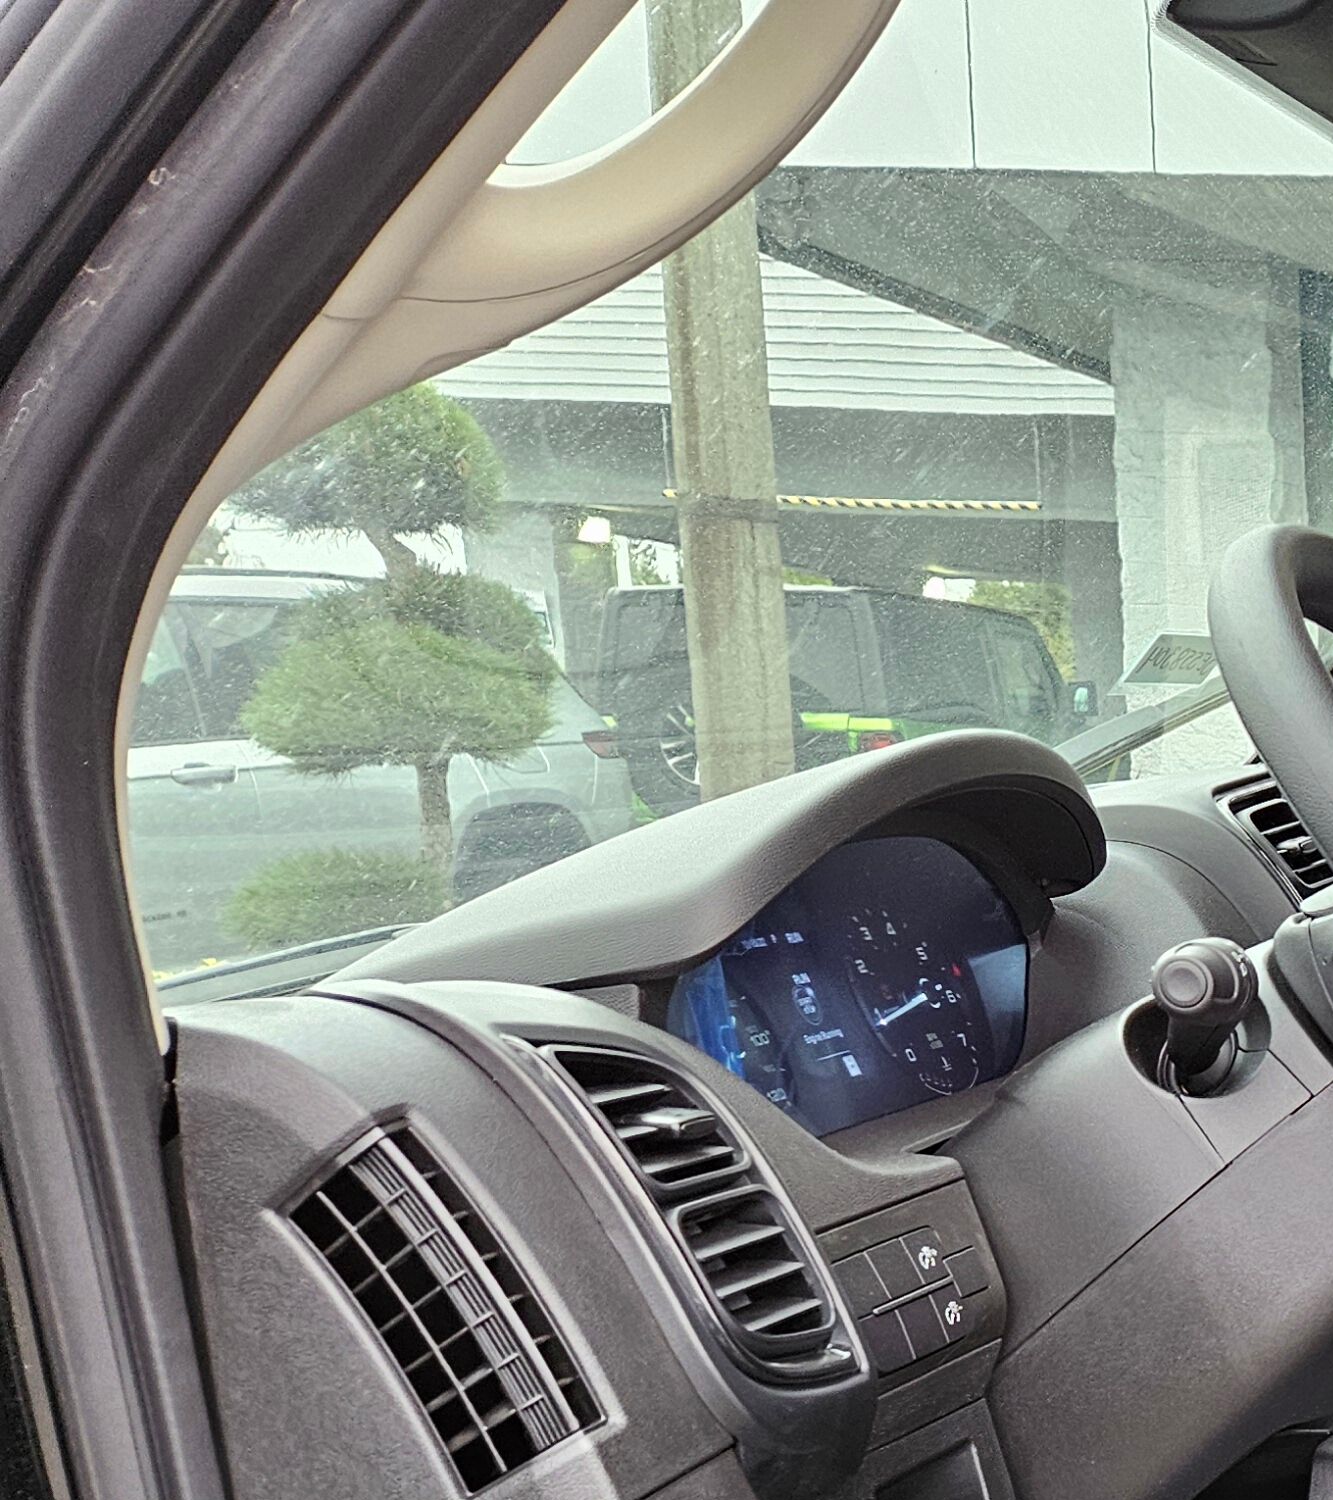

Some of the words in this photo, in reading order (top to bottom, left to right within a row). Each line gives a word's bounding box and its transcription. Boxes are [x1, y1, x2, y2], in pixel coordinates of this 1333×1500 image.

[859, 926, 872, 940] 3
[886, 922, 897, 935] 4
[915, 947, 928, 960] 5
[855, 959, 868, 973] 2
[945, 990, 957, 1003] 6
[957, 1033, 967, 1047] 7
[905, 1048, 917, 1062] 0
